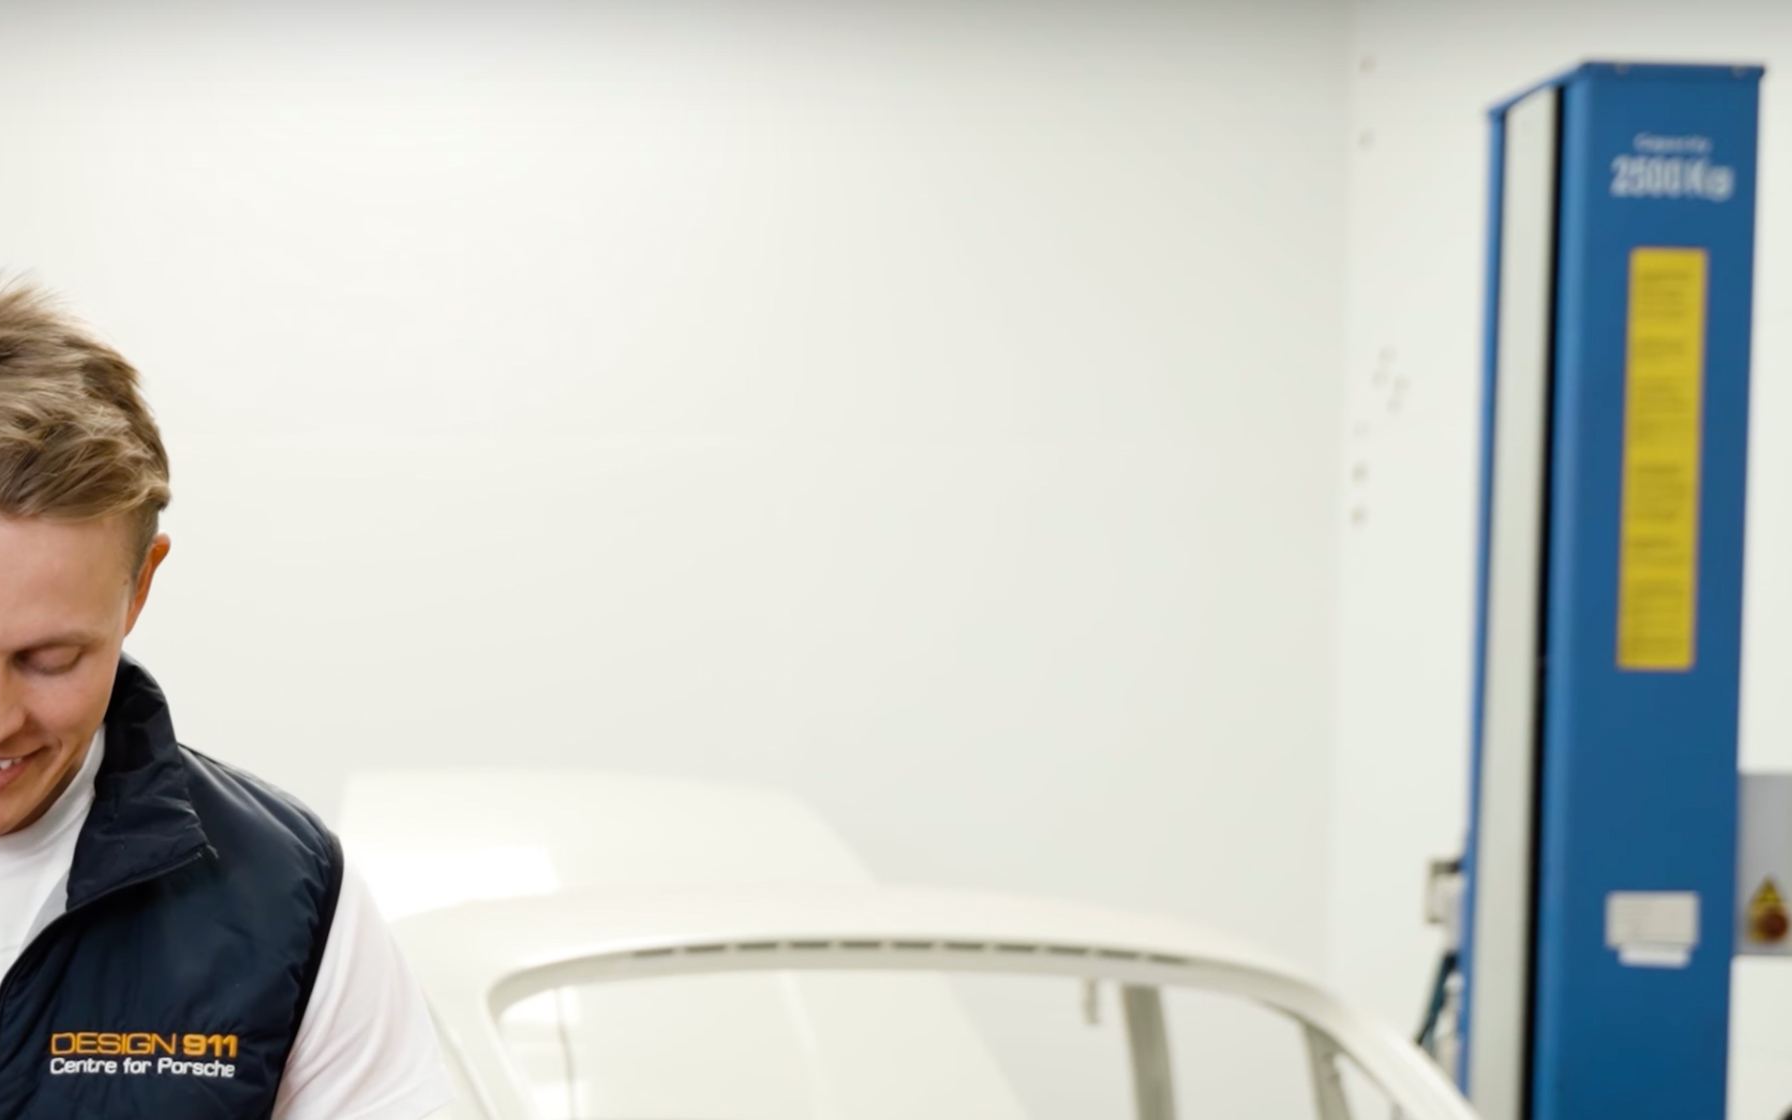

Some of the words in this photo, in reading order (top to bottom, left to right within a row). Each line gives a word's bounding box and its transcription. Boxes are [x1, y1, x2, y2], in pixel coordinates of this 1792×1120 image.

[51, 1032, 177, 1055] DESIGN
[182, 1033, 238, 1057] 911
[50, 1057, 117, 1075] Centre
[122, 1057, 152, 1074] for
[157, 1057, 236, 1078] Porsche
